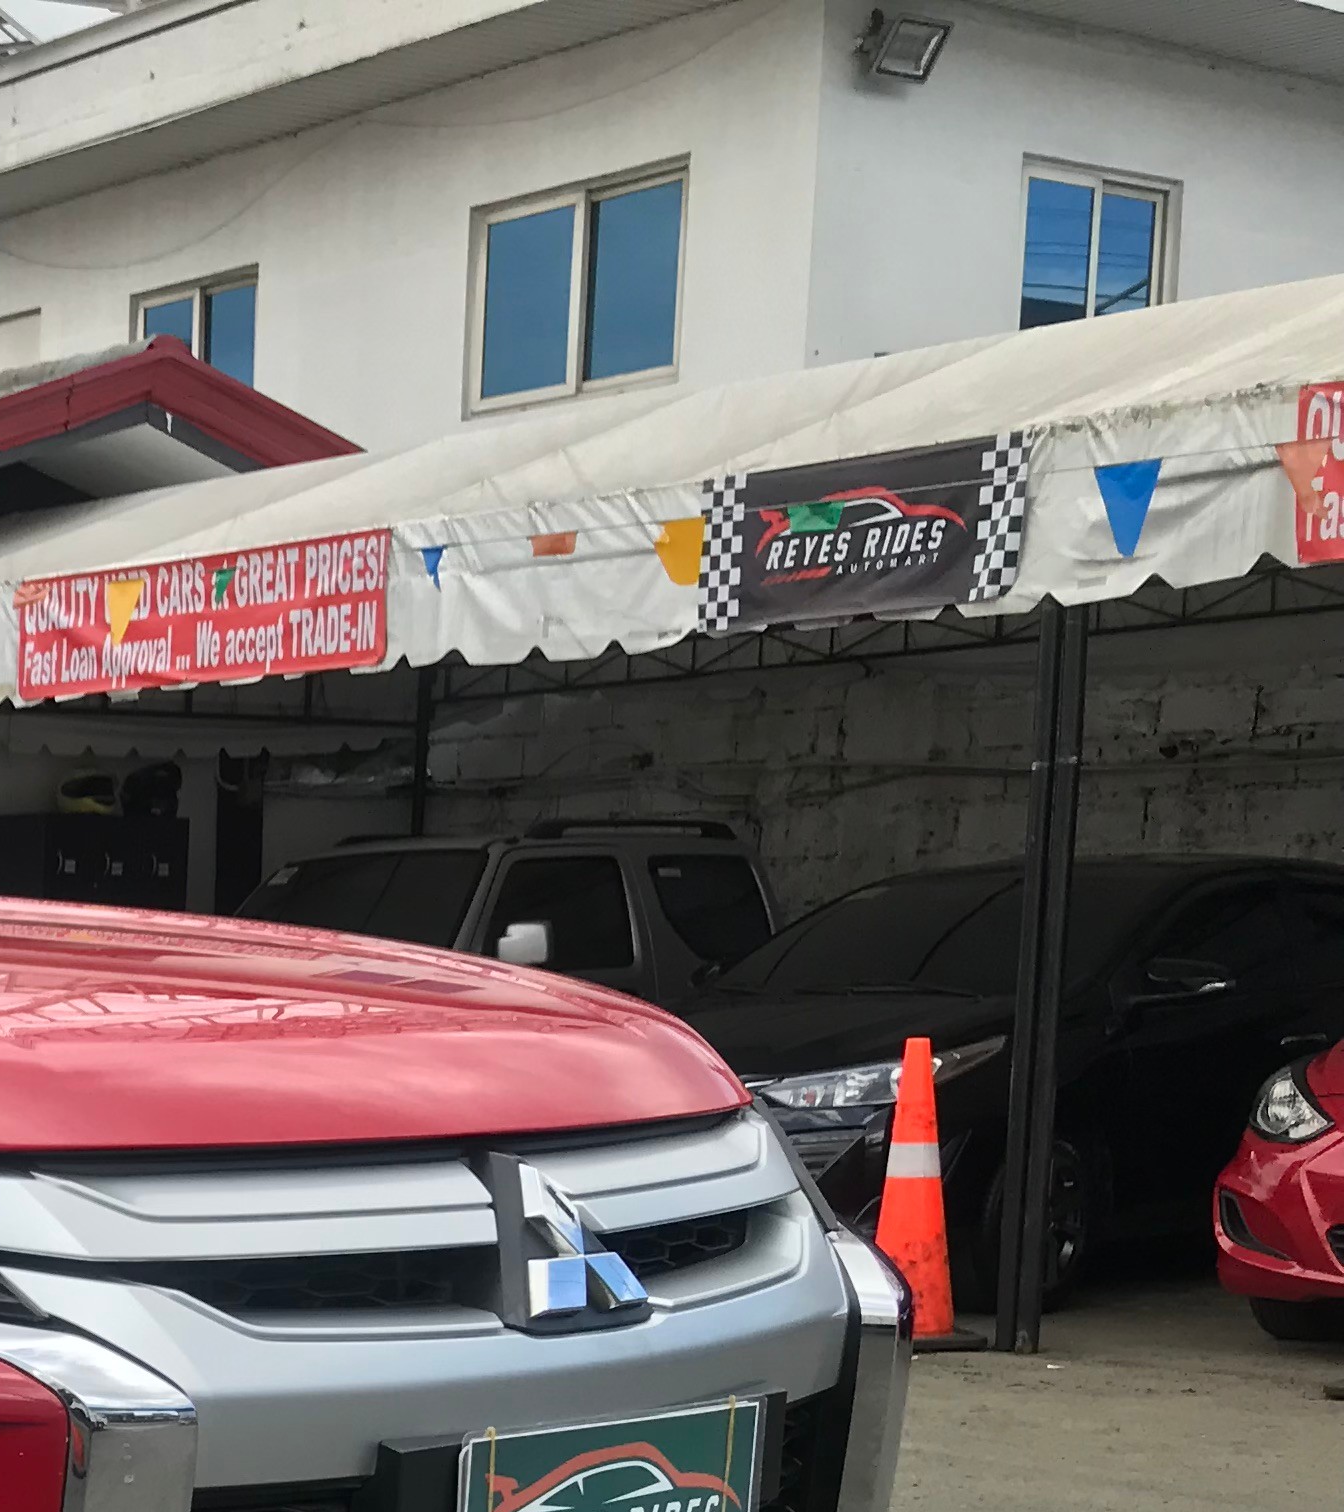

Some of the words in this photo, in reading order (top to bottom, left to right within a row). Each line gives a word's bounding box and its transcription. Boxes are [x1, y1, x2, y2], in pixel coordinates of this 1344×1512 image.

[156, 561, 206, 618] CARS
[234, 547, 299, 609] GREAT
[304, 535, 386, 600] PRICES!
[765, 531, 852, 571] REYES
[863, 518, 946, 559] RIDES
[836, 552, 939, 575] AUTOMART
[23, 639, 58, 687] Fast
[61, 637, 98, 683] Loan
[101, 625, 172, 690] Approval
[196, 619, 220, 669] We
[225, 612, 284, 673] accept
[288, 599, 378, 659] TRADE-IN
